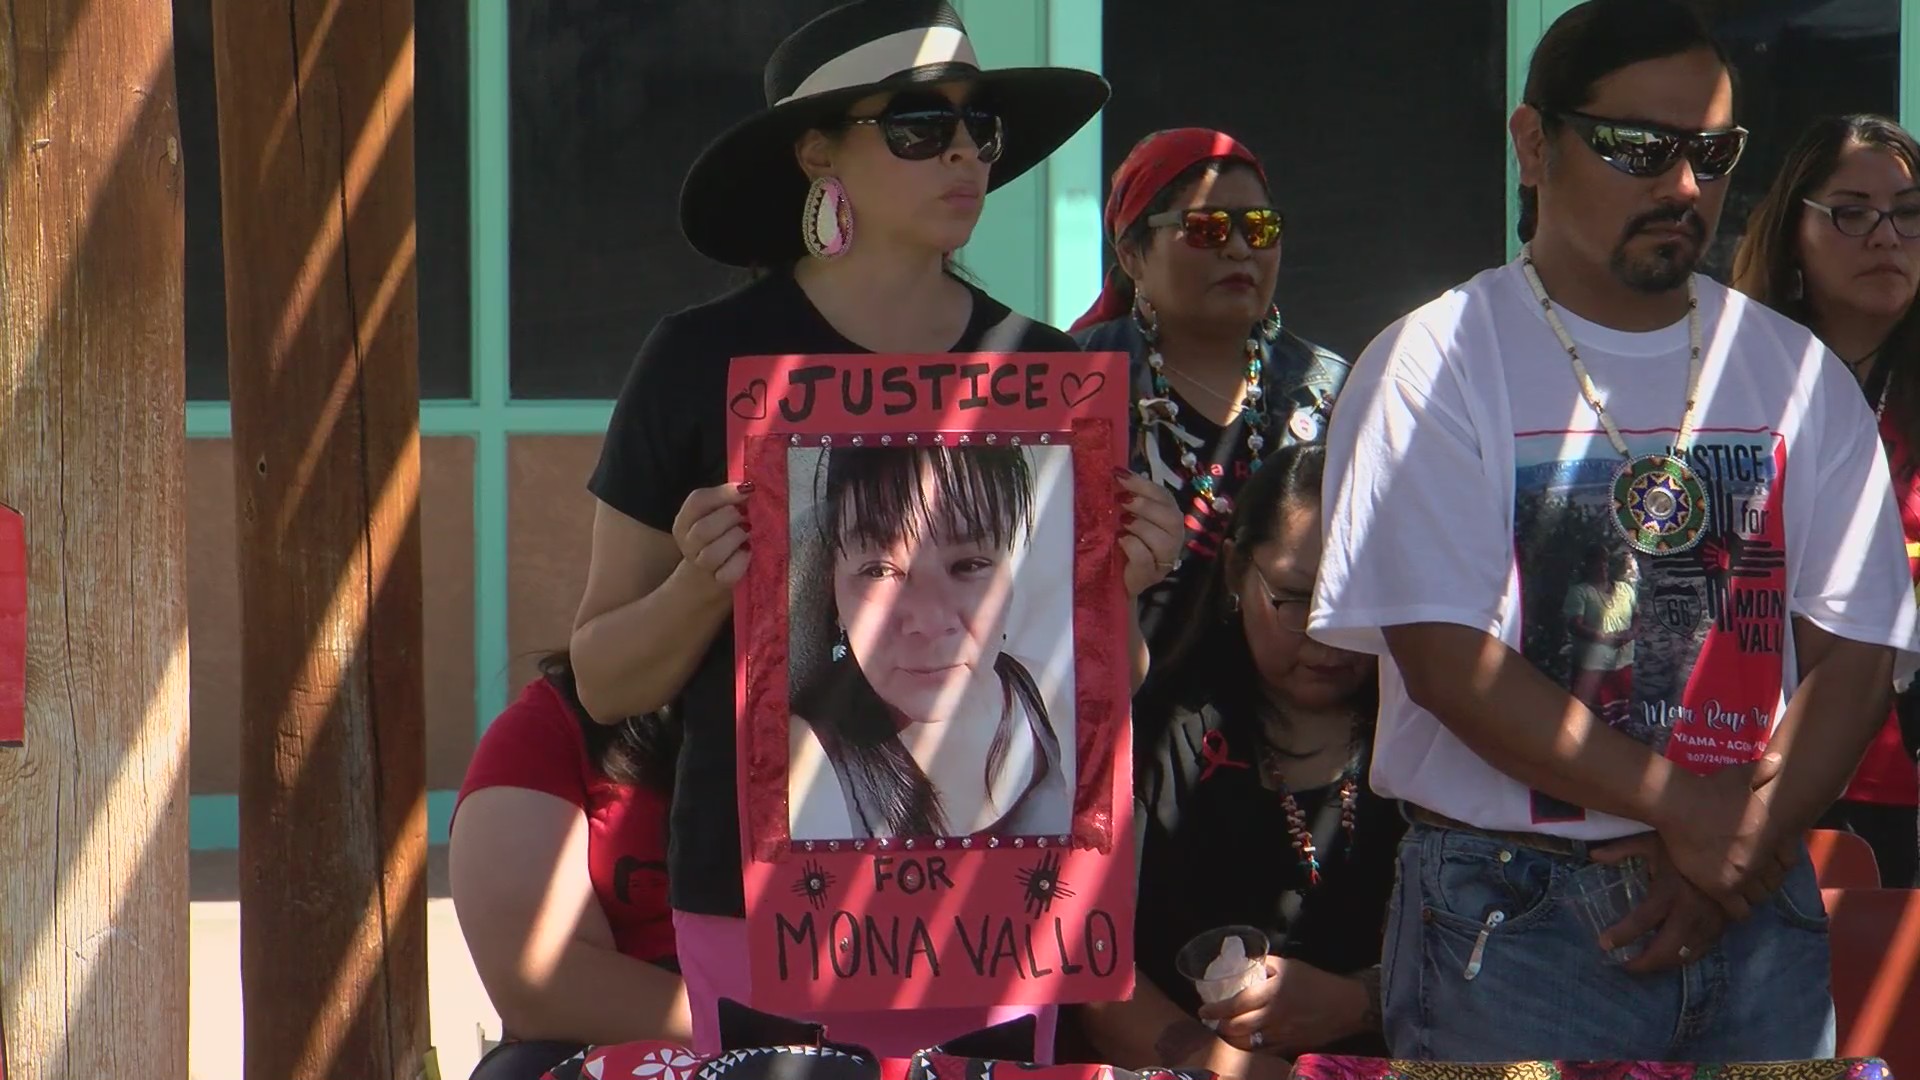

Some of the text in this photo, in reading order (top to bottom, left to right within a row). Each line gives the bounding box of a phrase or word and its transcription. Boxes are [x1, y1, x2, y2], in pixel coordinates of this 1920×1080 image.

[778, 363, 1050, 422] JUSTICE
[1666, 444, 1766, 483] STICE
[1741, 500, 1769, 535] for
[1667, 598, 1691, 627] 66
[873, 857, 954, 894] FOR
[775, 909, 1118, 982] MONA VALLO
